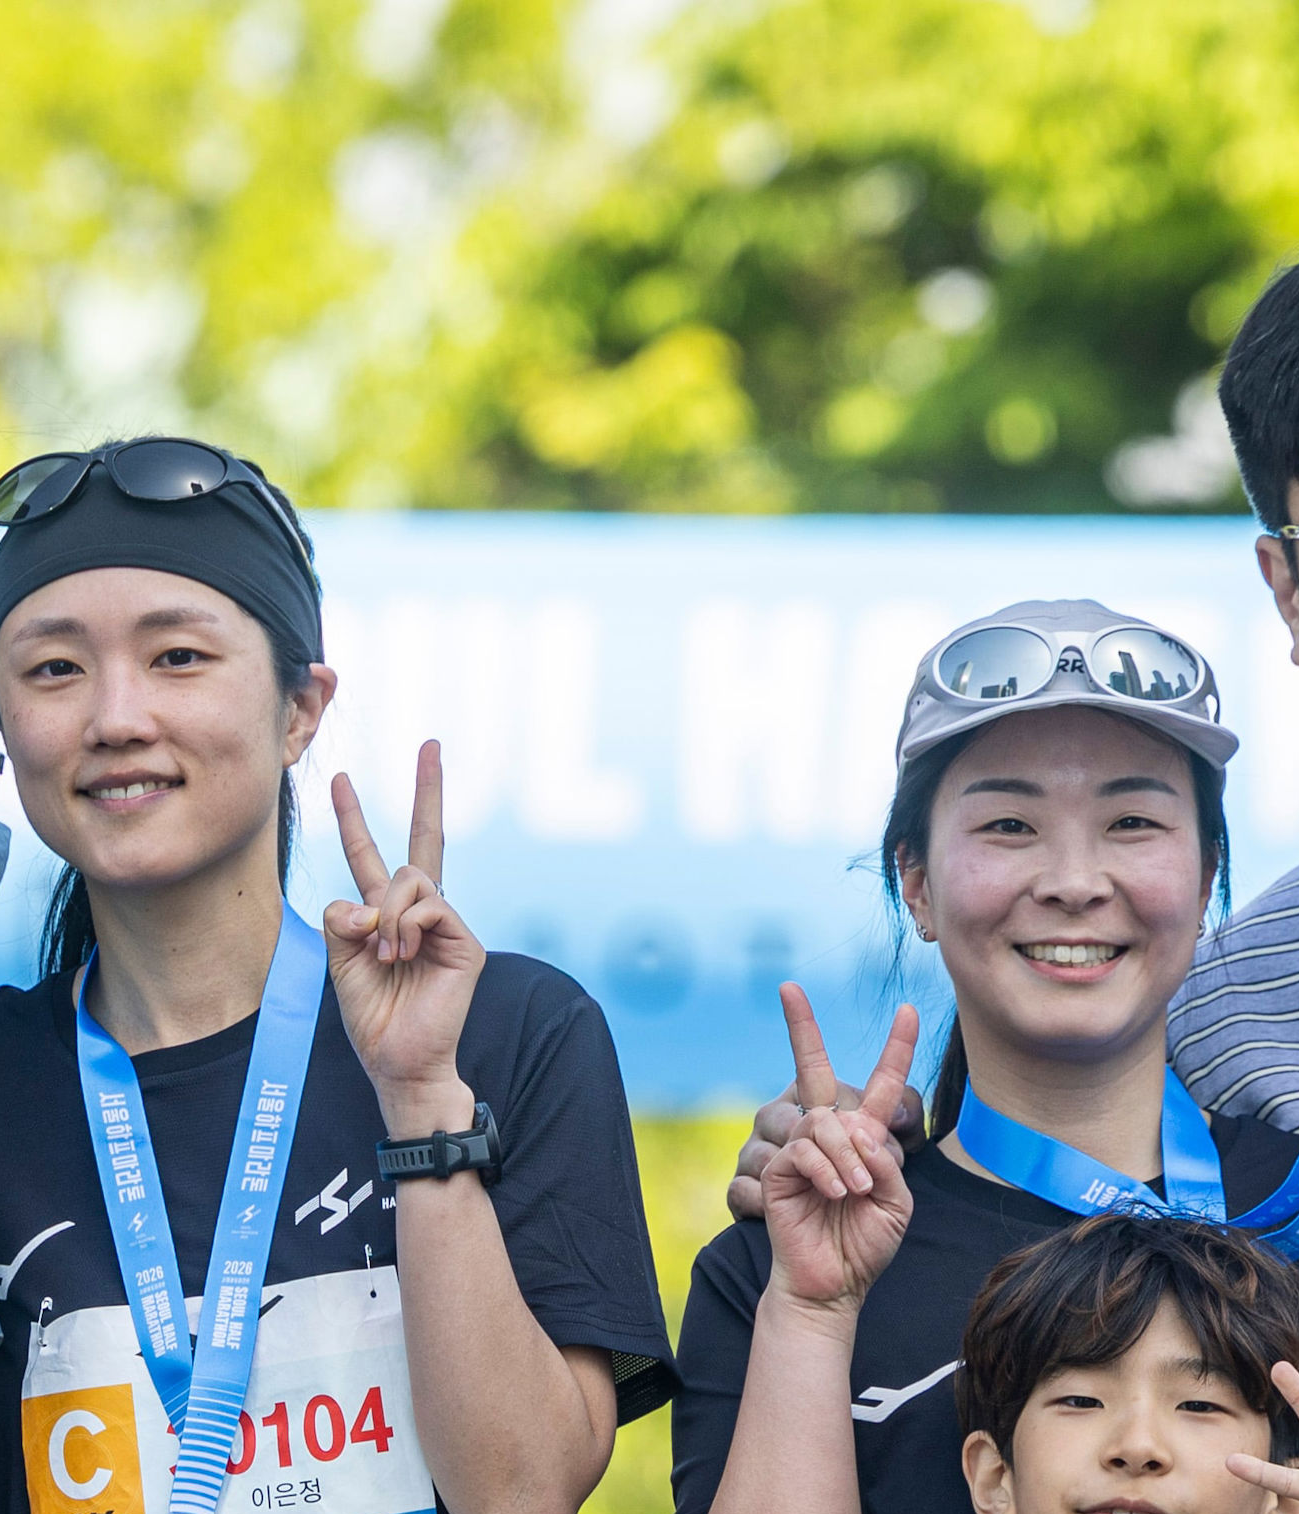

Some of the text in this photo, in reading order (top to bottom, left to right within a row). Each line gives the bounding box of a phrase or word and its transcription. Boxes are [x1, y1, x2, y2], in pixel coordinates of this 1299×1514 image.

[99, 1092, 146, 1204] 서울하프마라톤
[241, 1080, 289, 1192] 서울하프마라톤
[135, 1265, 164, 1287] 2026
[223, 1260, 253, 1275] 2026
[141, 1294, 166, 1359] MARATHON
[154, 1289, 178, 1351] SEOUL HALF
[211, 1285, 234, 1348] MARATHON
[231, 1286, 249, 1319] SEOUL
[226, 1321, 243, 1350] HALF
[48, 1410, 112, 1500] C
[167, 1386, 394, 1476] 0104
[251, 1477, 322, 1510] 이은정
